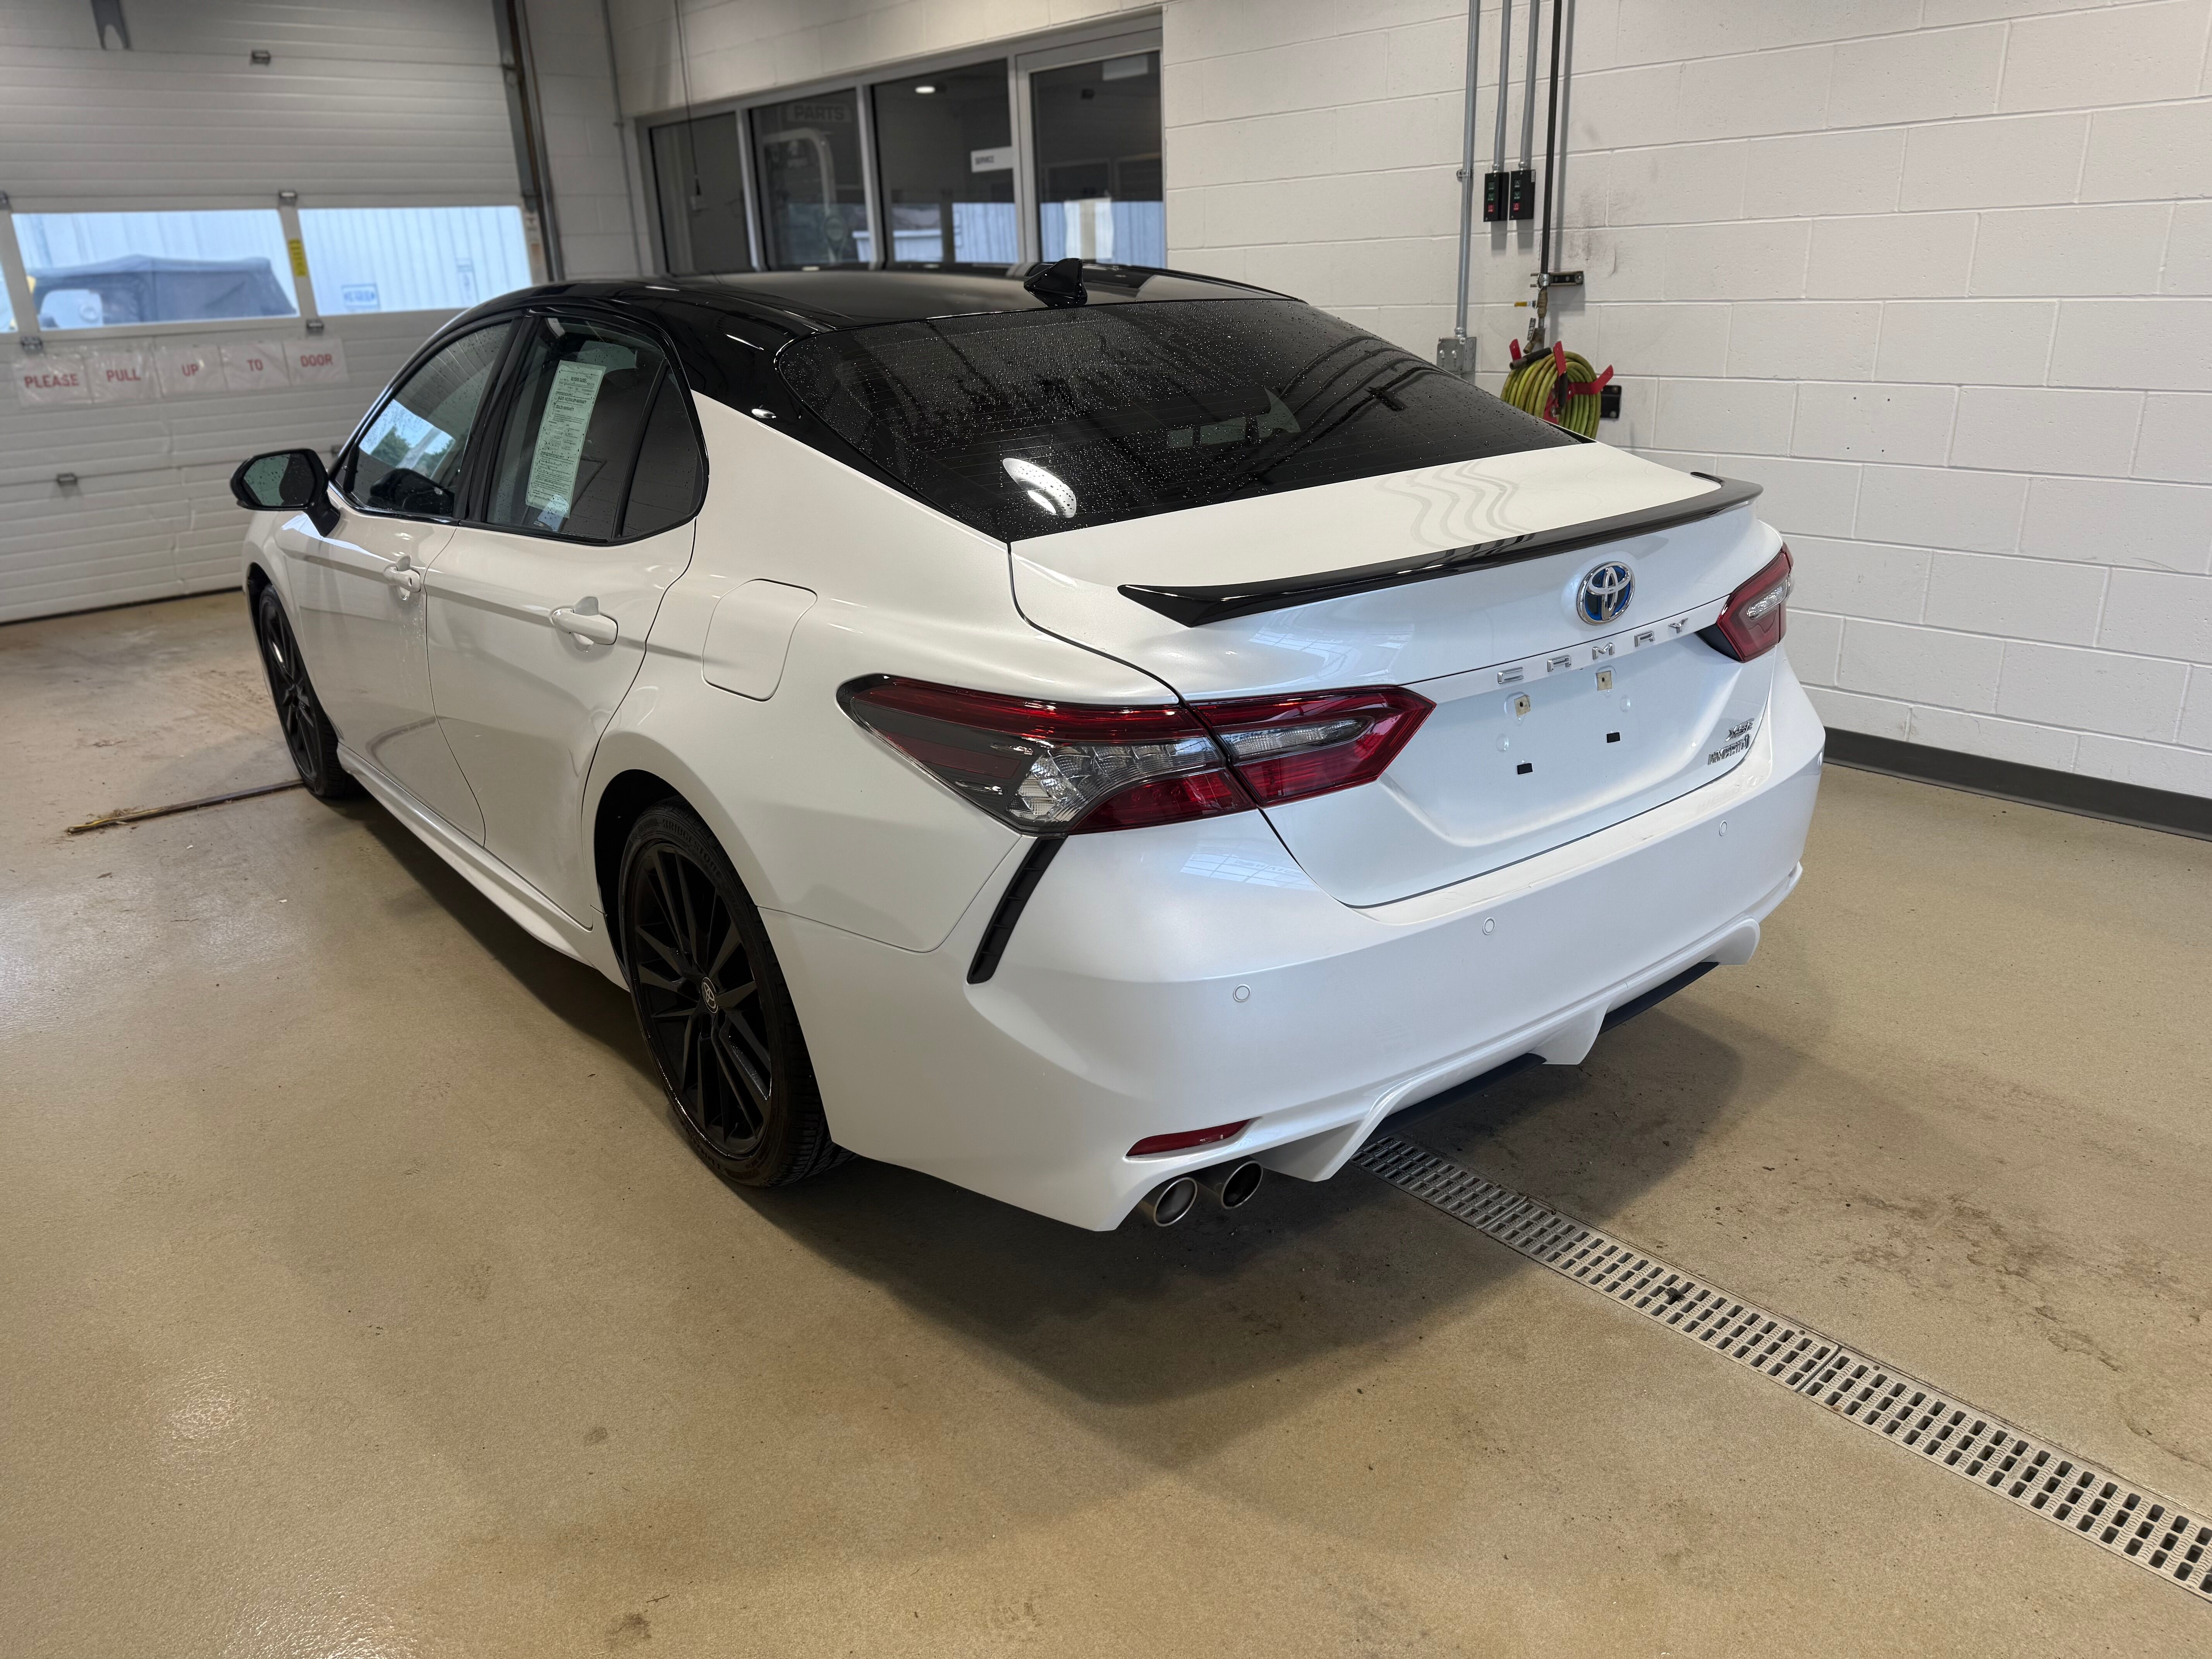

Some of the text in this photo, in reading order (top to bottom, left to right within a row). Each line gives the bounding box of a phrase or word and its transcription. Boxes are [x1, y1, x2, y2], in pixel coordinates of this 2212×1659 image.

[794, 105, 844, 120] PARTS
[24, 354, 333, 388] PLEASE PULL UP TO DOOR
[1498, 618, 1688, 684] CAMRY
[1725, 718, 1754, 741] XSE
